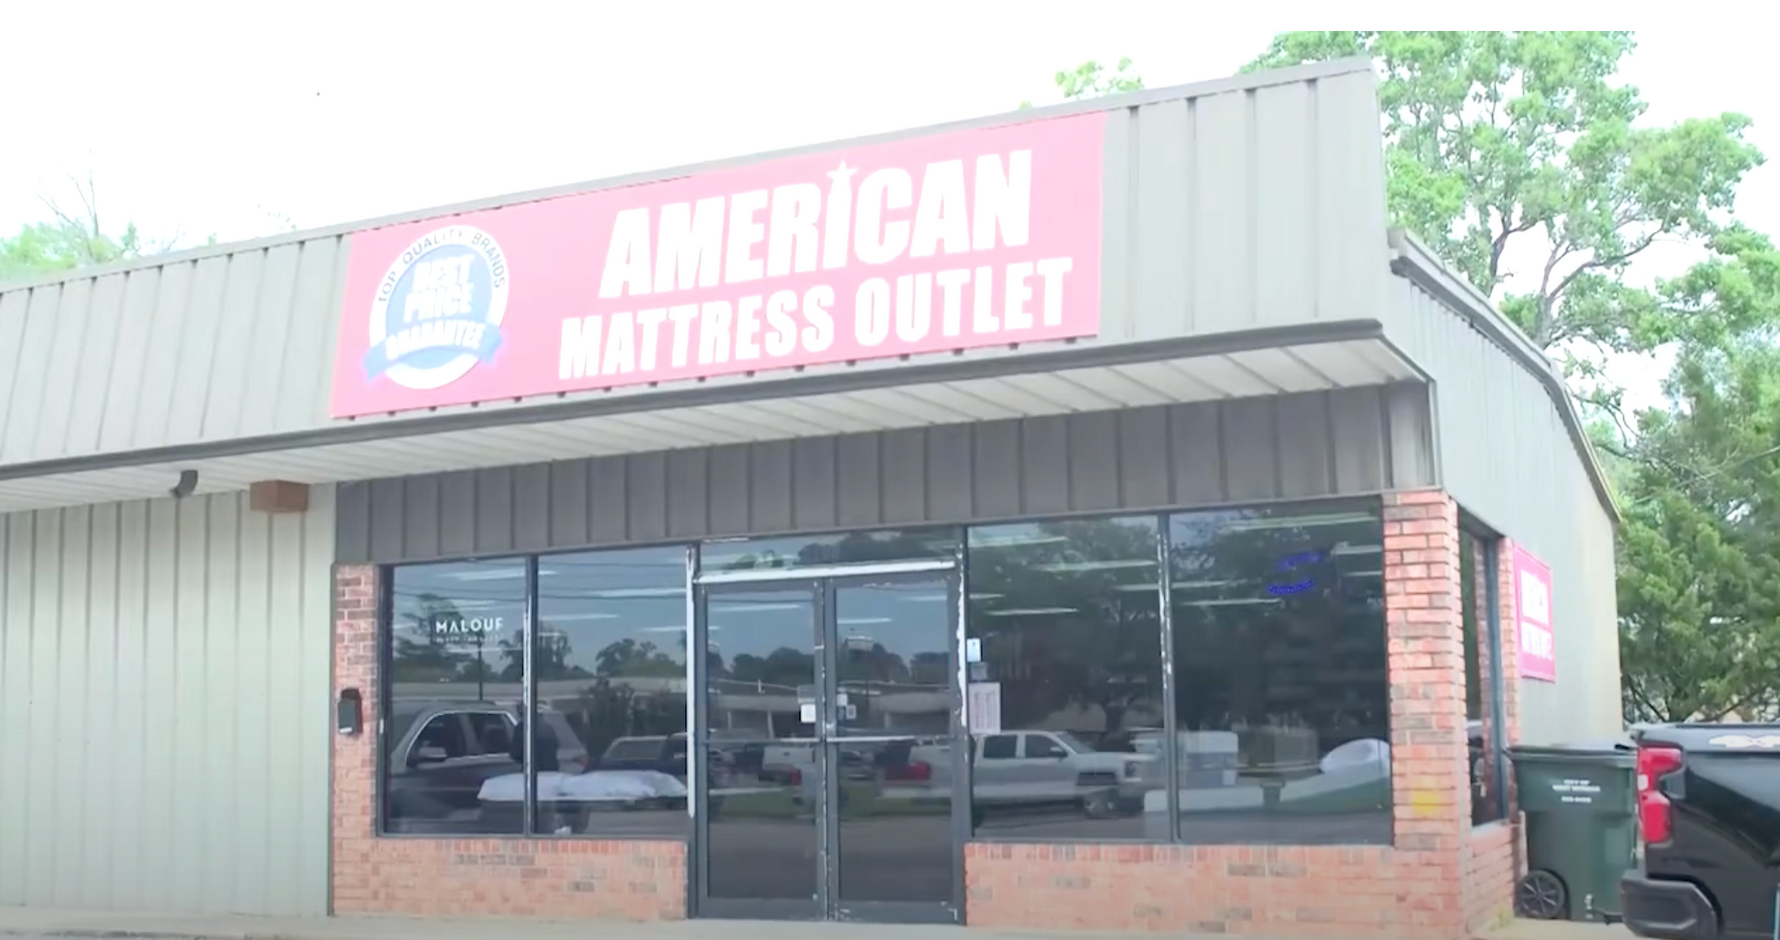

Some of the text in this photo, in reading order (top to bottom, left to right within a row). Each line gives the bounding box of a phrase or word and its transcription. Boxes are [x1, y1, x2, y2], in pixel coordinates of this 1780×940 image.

[598, 149, 1032, 298] AMERICAN
[377, 228, 506, 303] TOP QUALITY BRANDS
[413, 253, 475, 292] BEST
[403, 283, 475, 323] PRICE
[558, 256, 1074, 381] MATTRESS OUTLET
[435, 617, 504, 634] MALOUF
